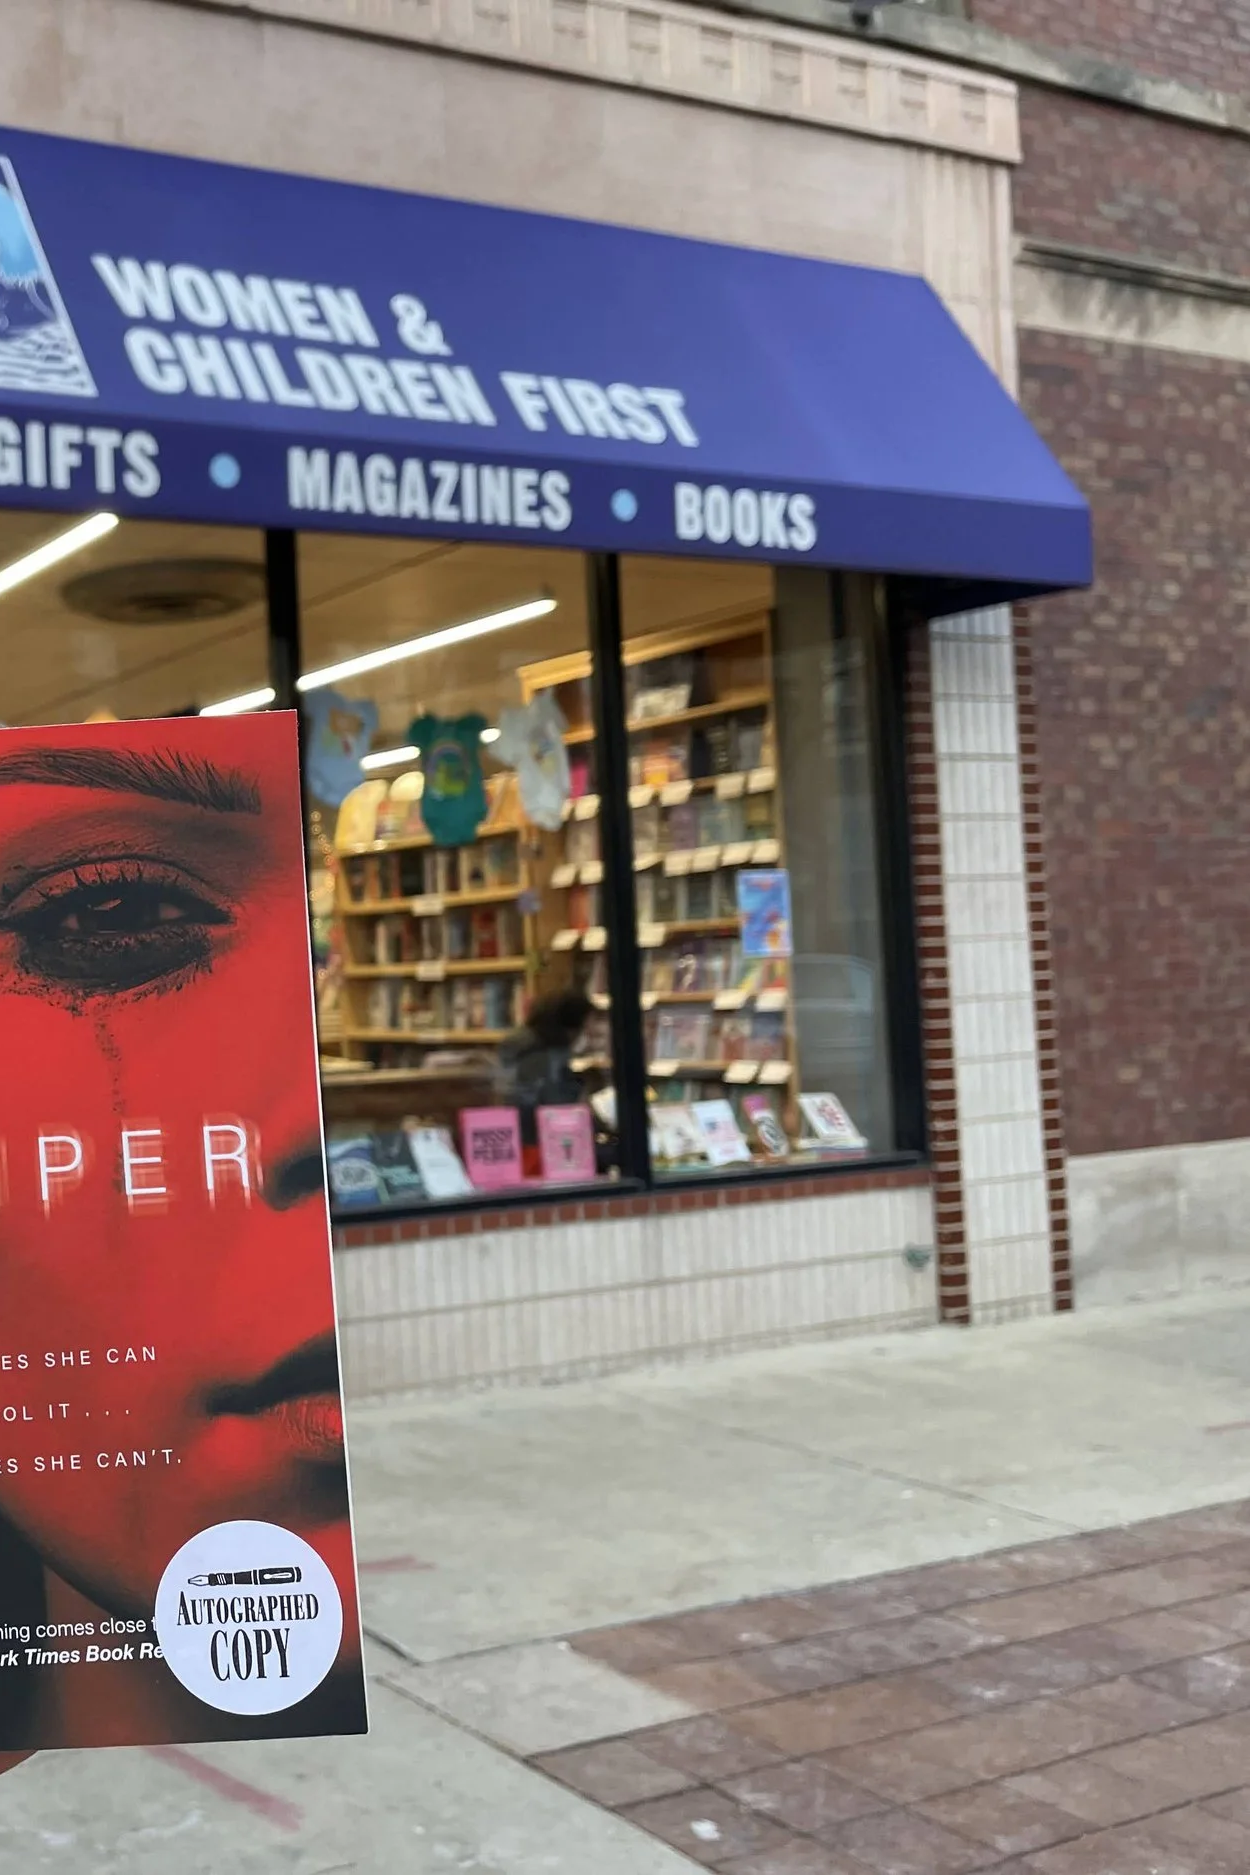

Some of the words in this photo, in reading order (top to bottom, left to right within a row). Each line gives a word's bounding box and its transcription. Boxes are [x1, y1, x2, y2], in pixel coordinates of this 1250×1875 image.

[92, 254, 379, 347] WOMEN
[391, 295, 449, 355] &
[124, 327, 496, 426] CHILDREN
[501, 372, 698, 447] FIRST
[289, 448, 571, 531] MAGAZINES
[675, 482, 816, 551] BOOKS
[44, 1350, 91, 1368] SHE
[106, 1346, 156, 1364] CAN
[48, 1403, 70, 1419] IT
[34, 1454, 82, 1472] SHE
[96, 1449, 181, 1468] CAN'T.
[35, 1622, 95, 1638] comes
[99, 1617, 147, 1635] close
[24, 1648, 81, 1665] Times
[85, 1643, 135, 1663] Book
[210, 1628, 290, 1682] COPY
